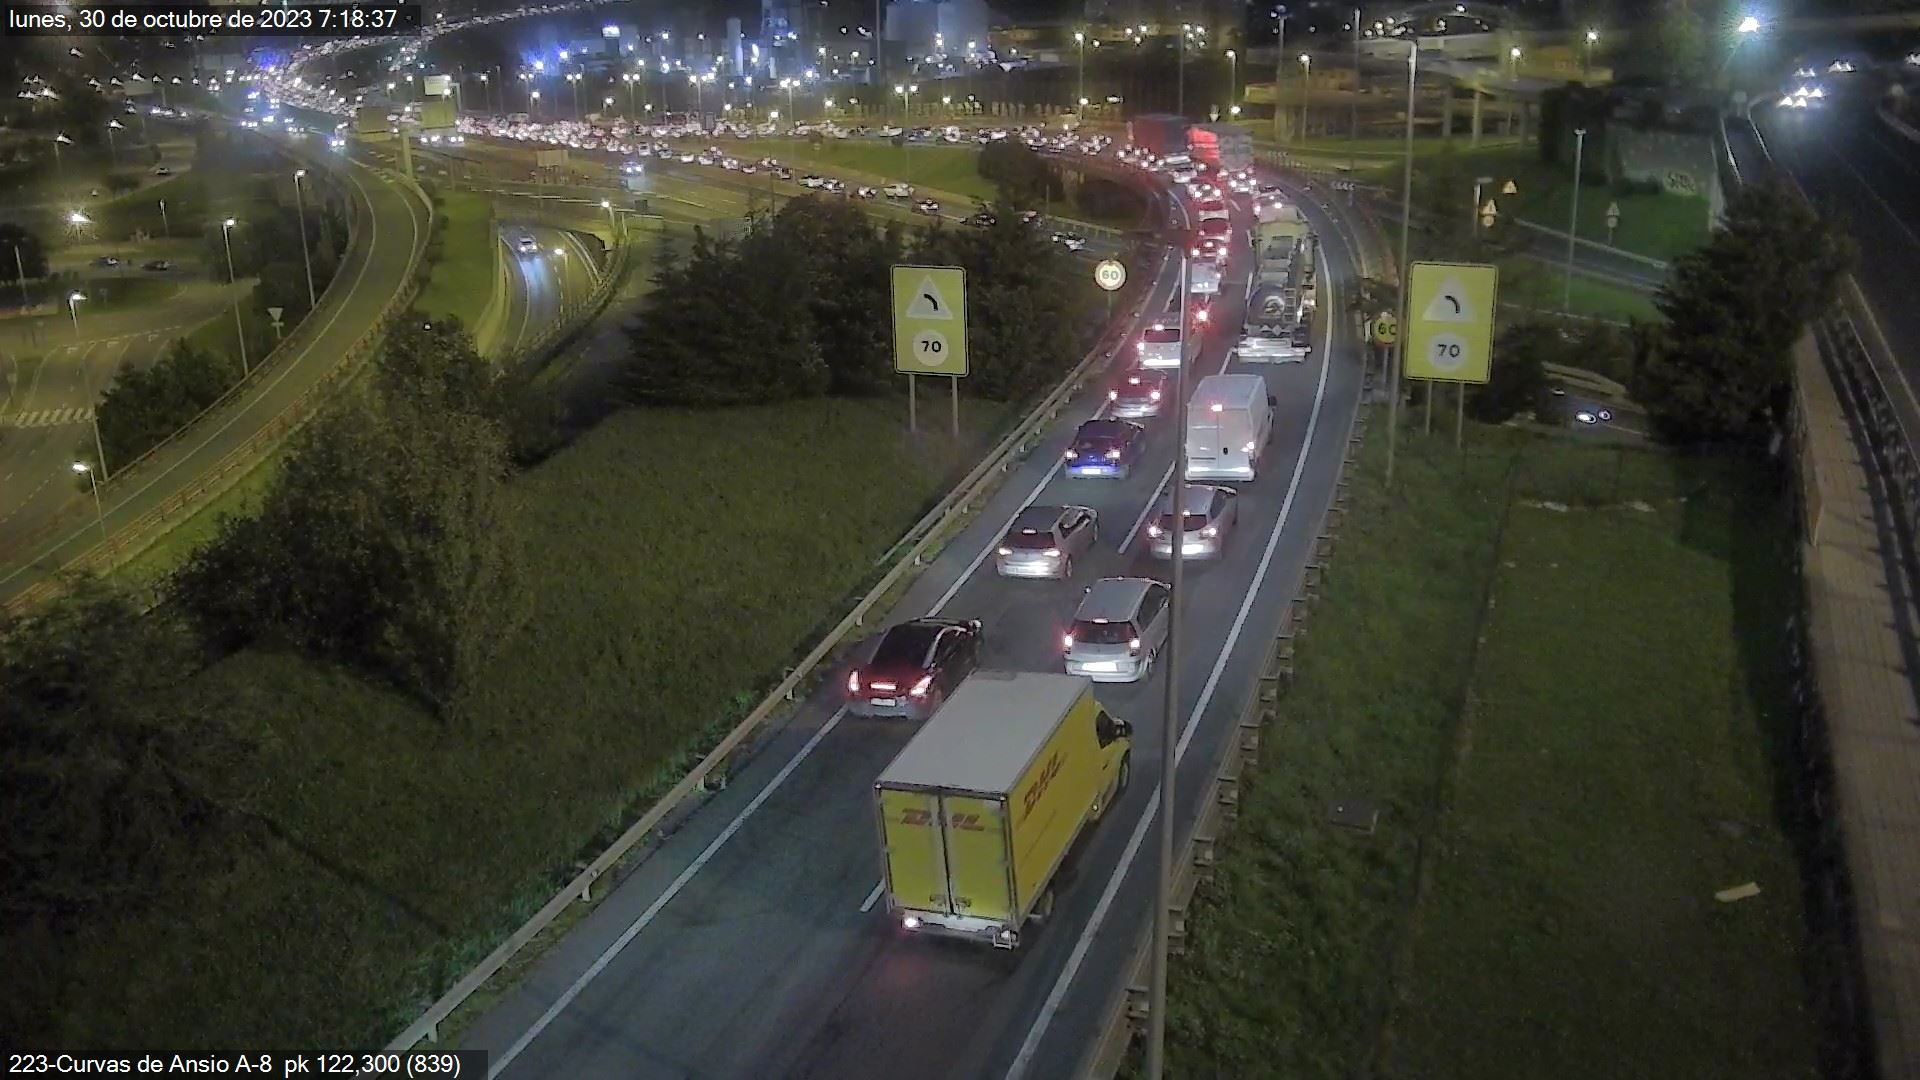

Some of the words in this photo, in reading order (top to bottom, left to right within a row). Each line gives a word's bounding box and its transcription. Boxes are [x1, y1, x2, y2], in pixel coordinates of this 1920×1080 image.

[1102, 270, 1119, 280] 60
[921, 340, 942, 353] 70
[1437, 343, 1461, 358] 70
[1023, 751, 1068, 821] DHL
[901, 808, 985, 832] DHL
